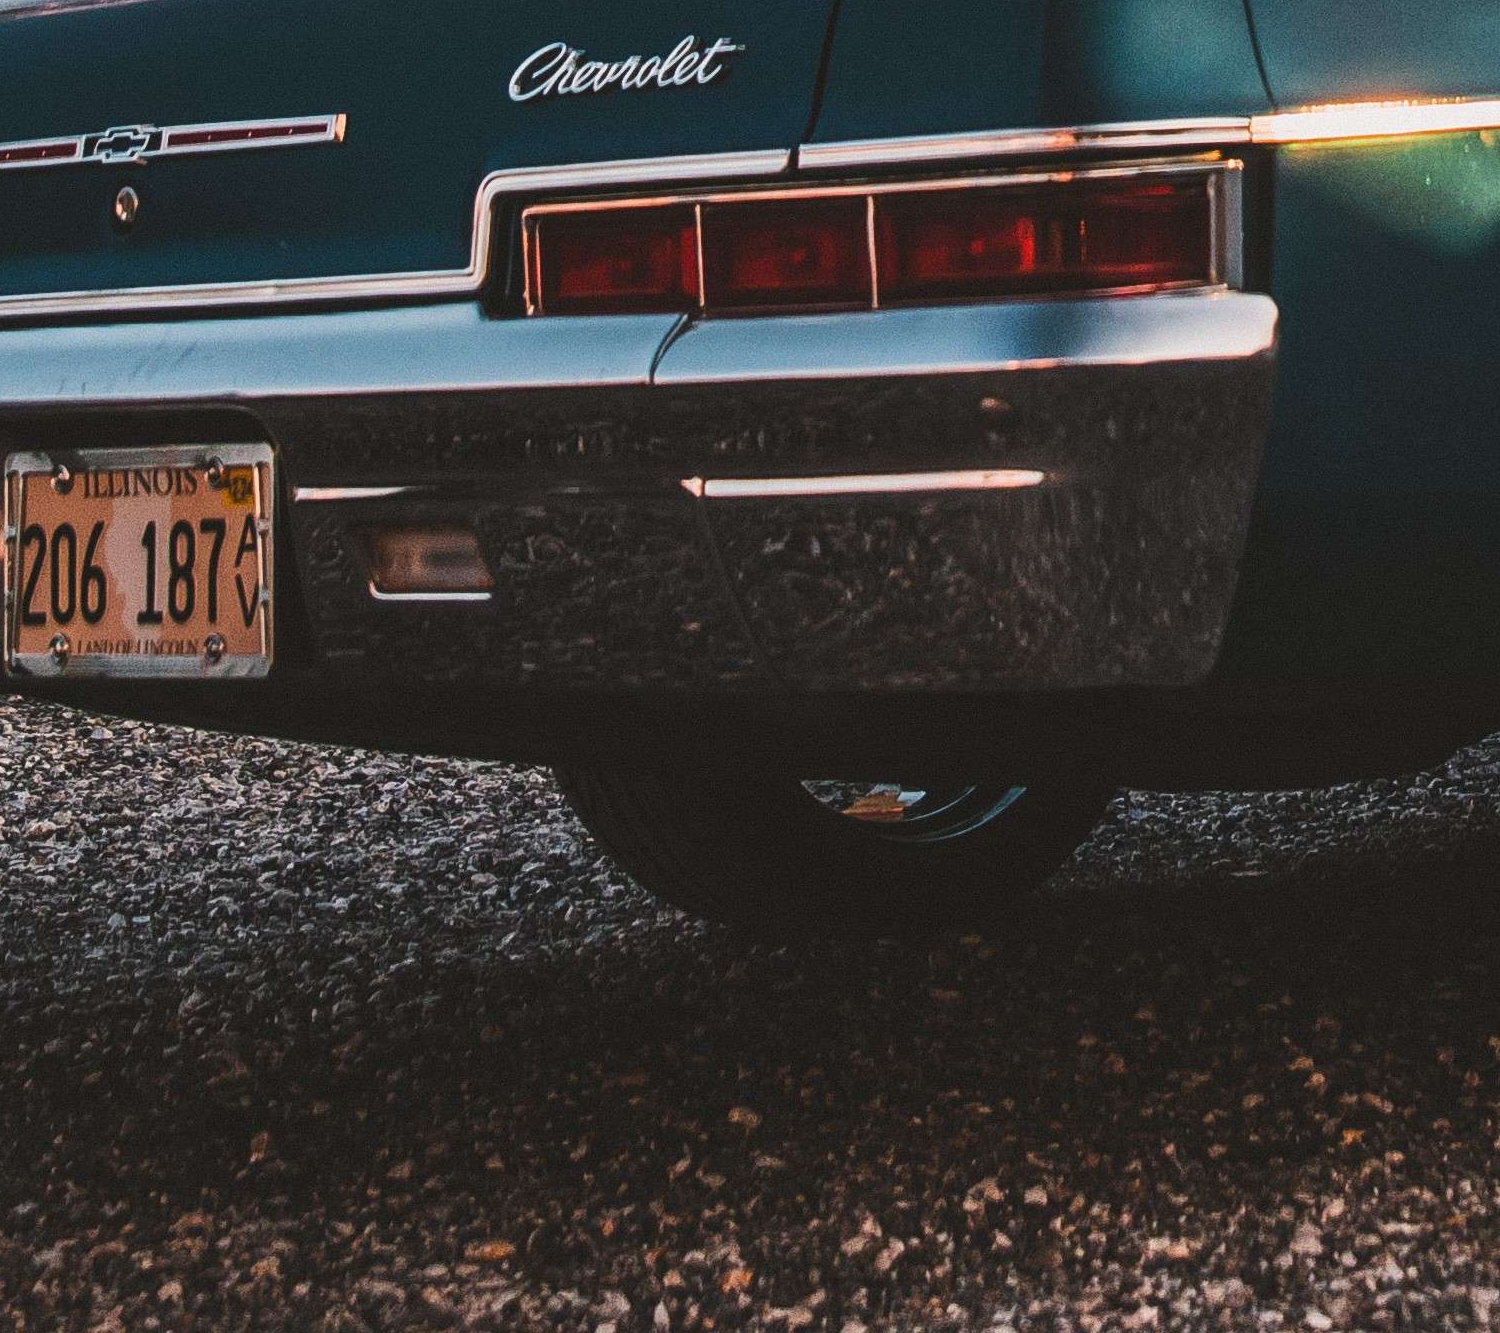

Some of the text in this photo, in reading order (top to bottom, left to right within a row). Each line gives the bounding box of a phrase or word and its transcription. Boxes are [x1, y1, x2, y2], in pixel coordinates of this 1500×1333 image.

[509, 35, 740, 101] Chevrolet
[83, 468, 198, 499] ILLINOIS
[19, 520, 108, 626] 206
[136, 517, 226, 626] 187
